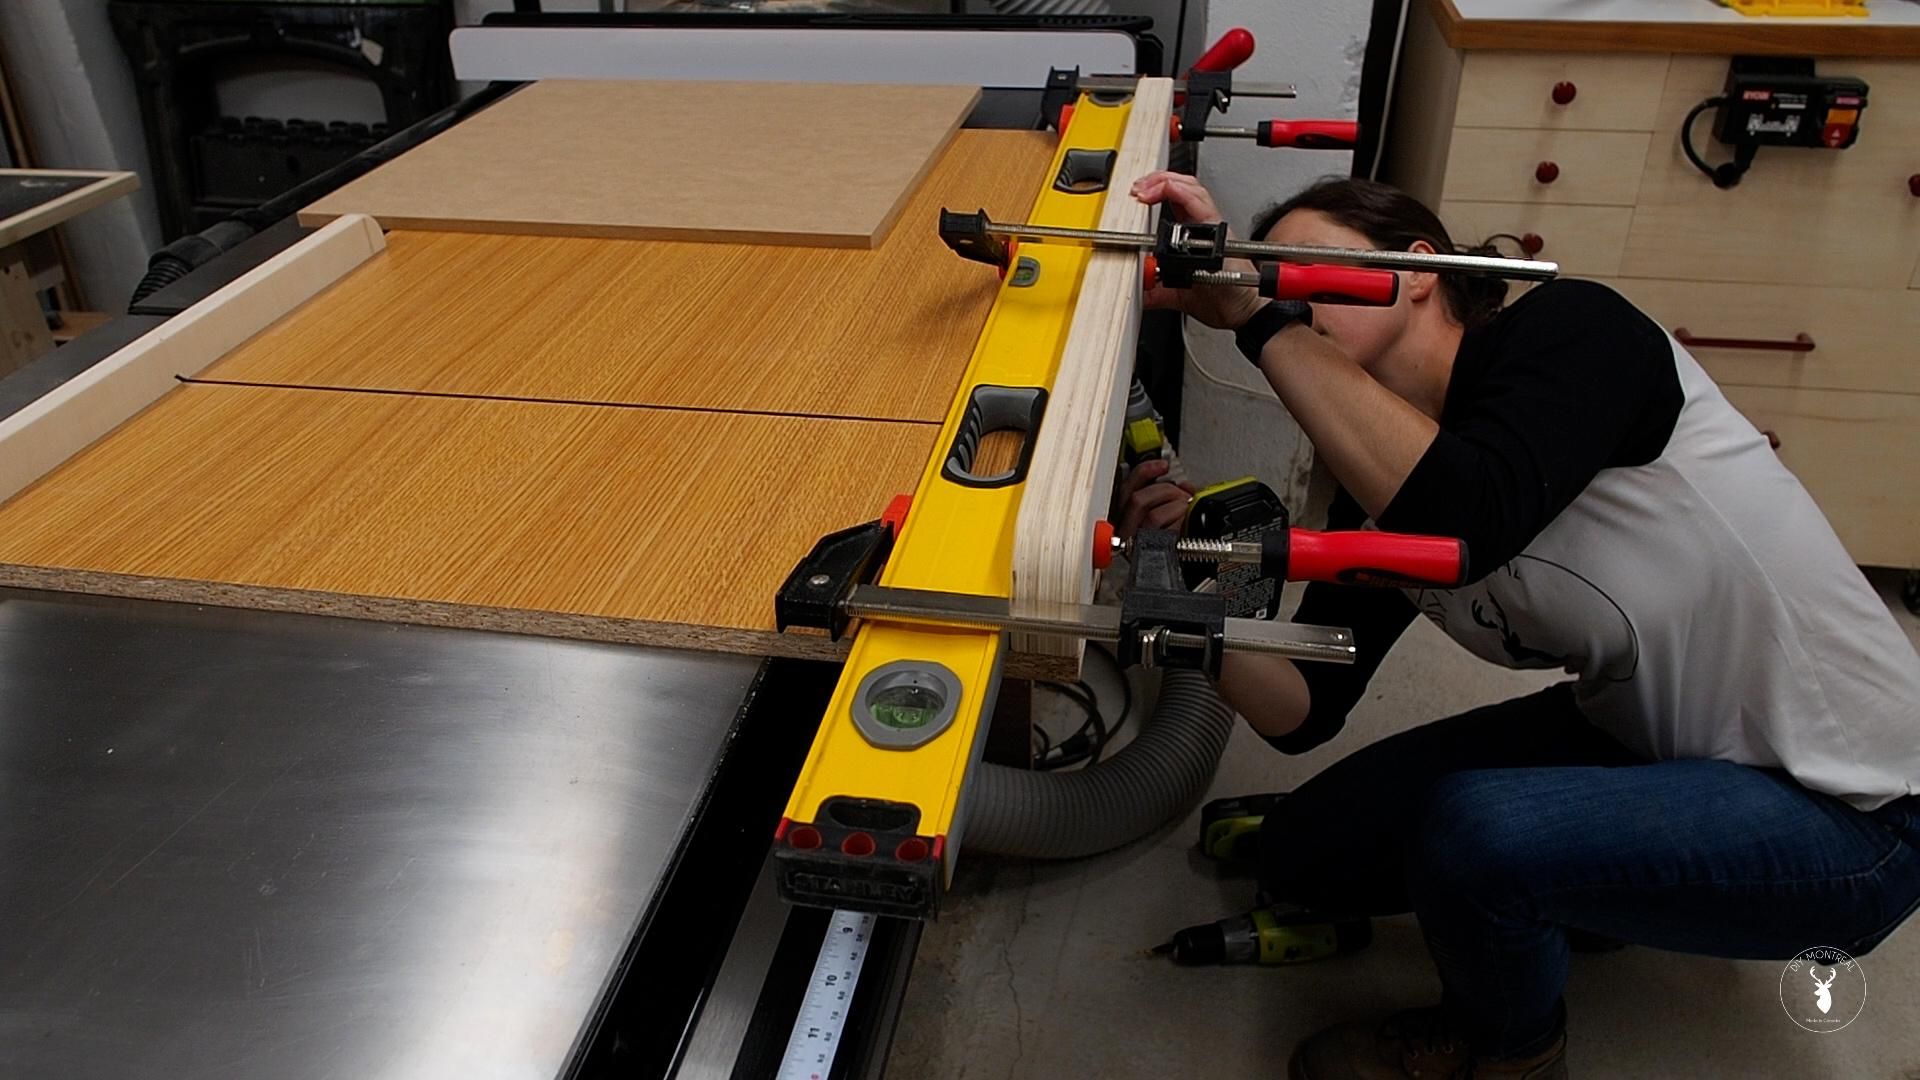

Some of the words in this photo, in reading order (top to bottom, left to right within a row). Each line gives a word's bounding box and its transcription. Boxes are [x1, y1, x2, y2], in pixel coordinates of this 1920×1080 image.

[842, 926, 854, 934] 9
[825, 975, 837, 987] 10
[808, 1027, 820, 1039] 11
